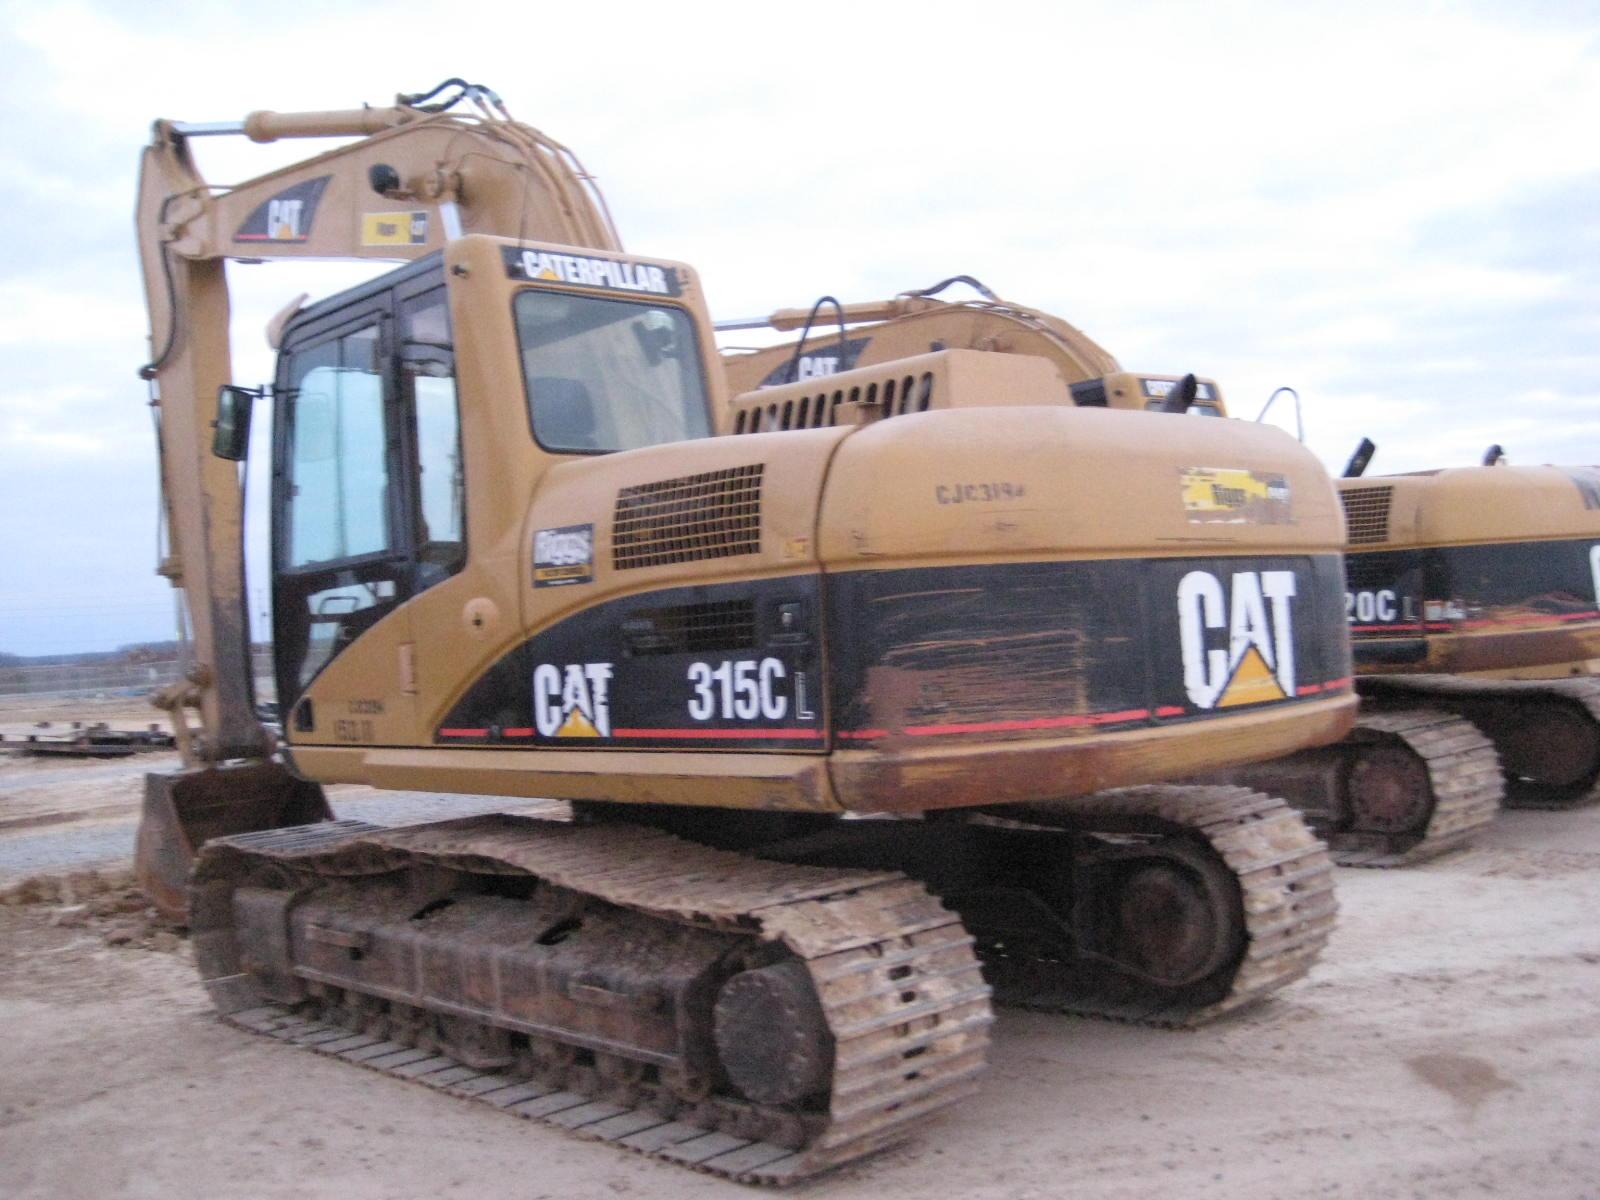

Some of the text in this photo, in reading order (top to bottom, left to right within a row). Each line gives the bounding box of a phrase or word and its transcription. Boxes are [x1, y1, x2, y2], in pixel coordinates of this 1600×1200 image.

[268, 199, 304, 239] CAT
[521, 250, 670, 294] CATERPILLAR
[1177, 571, 1297, 709] CAT
[533, 662, 614, 738] CAT
[687, 657, 815, 721] 315C L
